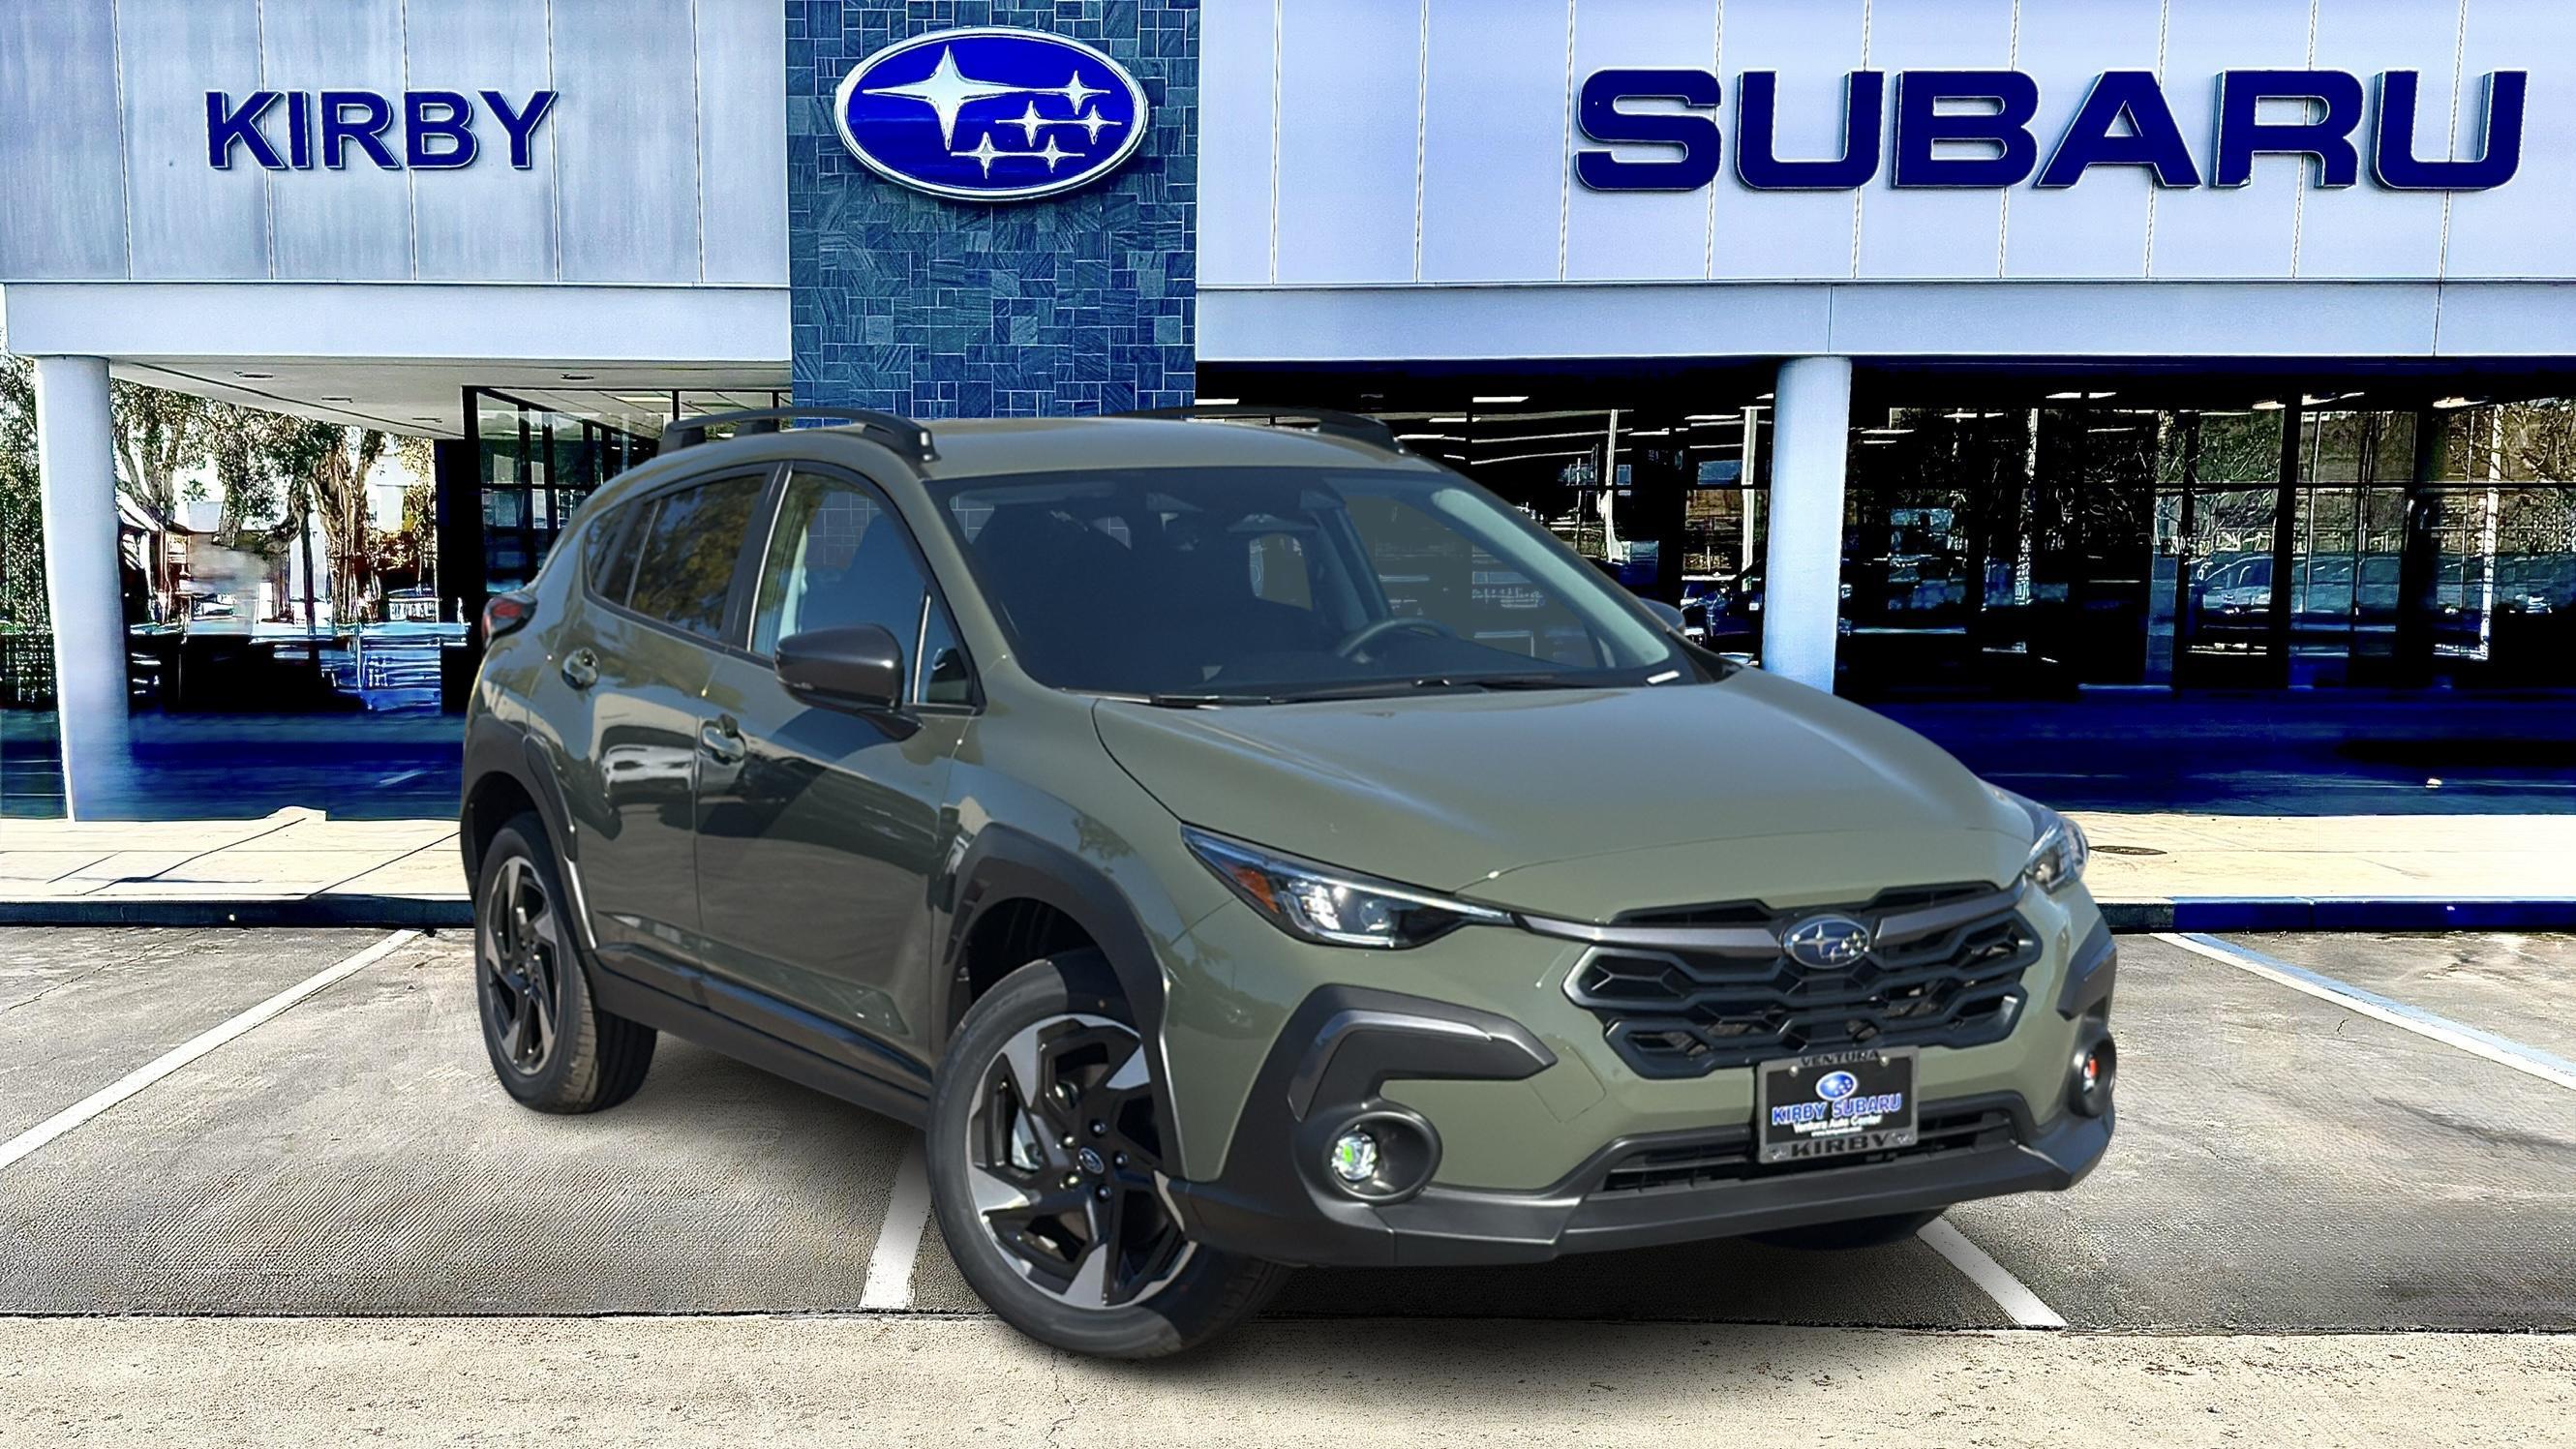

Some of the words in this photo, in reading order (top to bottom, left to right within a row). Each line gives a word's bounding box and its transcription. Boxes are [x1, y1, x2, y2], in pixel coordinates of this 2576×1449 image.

[205, 90, 559, 170] KIRBY
[1574, 68, 2528, 192] SUBARU
[1801, 1049, 1881, 1067] VENTURA
[1772, 1102, 1828, 1126] KIRBY
[1832, 1093, 1902, 1118] SUBARU
[1851, 1113, 1882, 1127] Center
[1792, 1133, 1889, 1158] KIRBY
